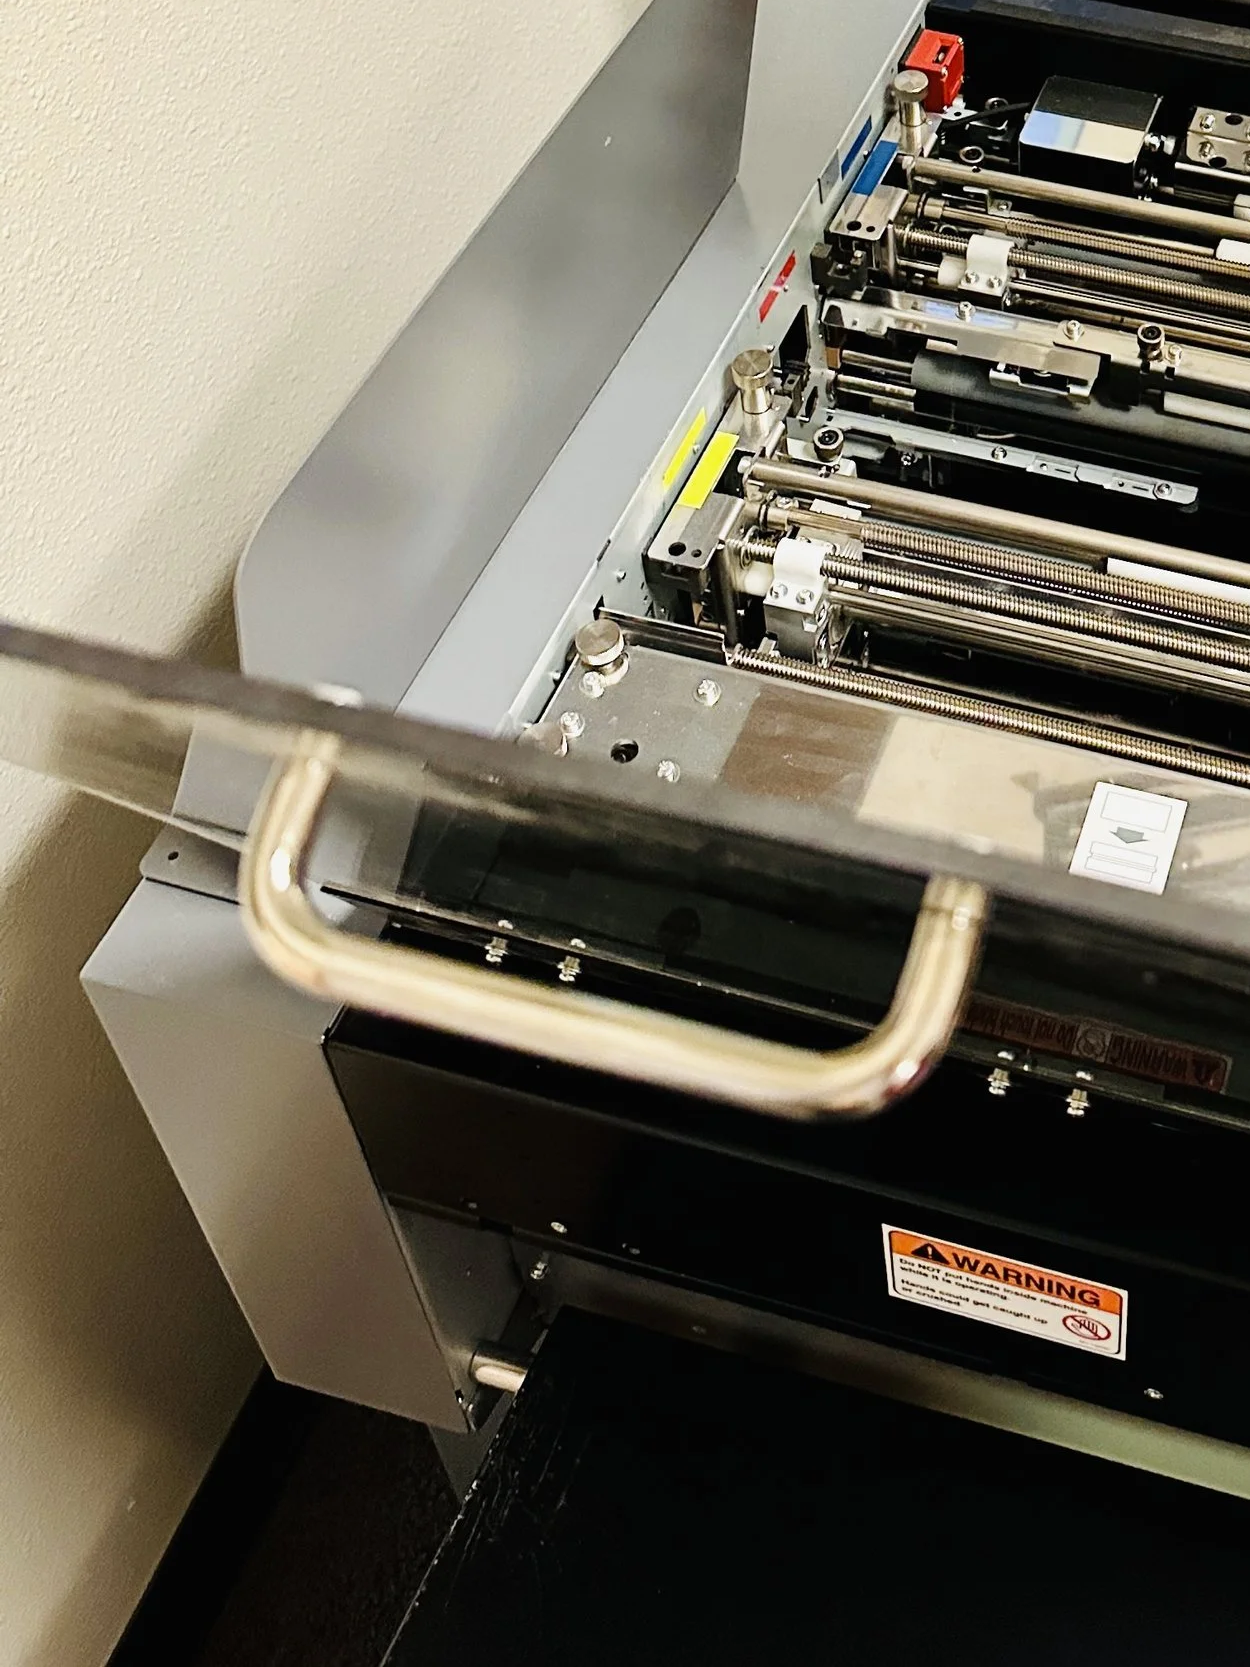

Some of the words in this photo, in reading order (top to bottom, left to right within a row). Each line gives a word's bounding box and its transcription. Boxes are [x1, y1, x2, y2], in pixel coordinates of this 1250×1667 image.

[901, 1279, 936, 1292] Hands
[992, 1304, 1031, 1320] caught
[917, 1262, 942, 1274] NOT
[945, 1269, 963, 1280] put
[965, 1274, 1001, 1291] hands
[1003, 1284, 1038, 1301] inside
[1040, 1296, 1088, 1314] machine
[951, 1252, 1100, 1307] WARNING
